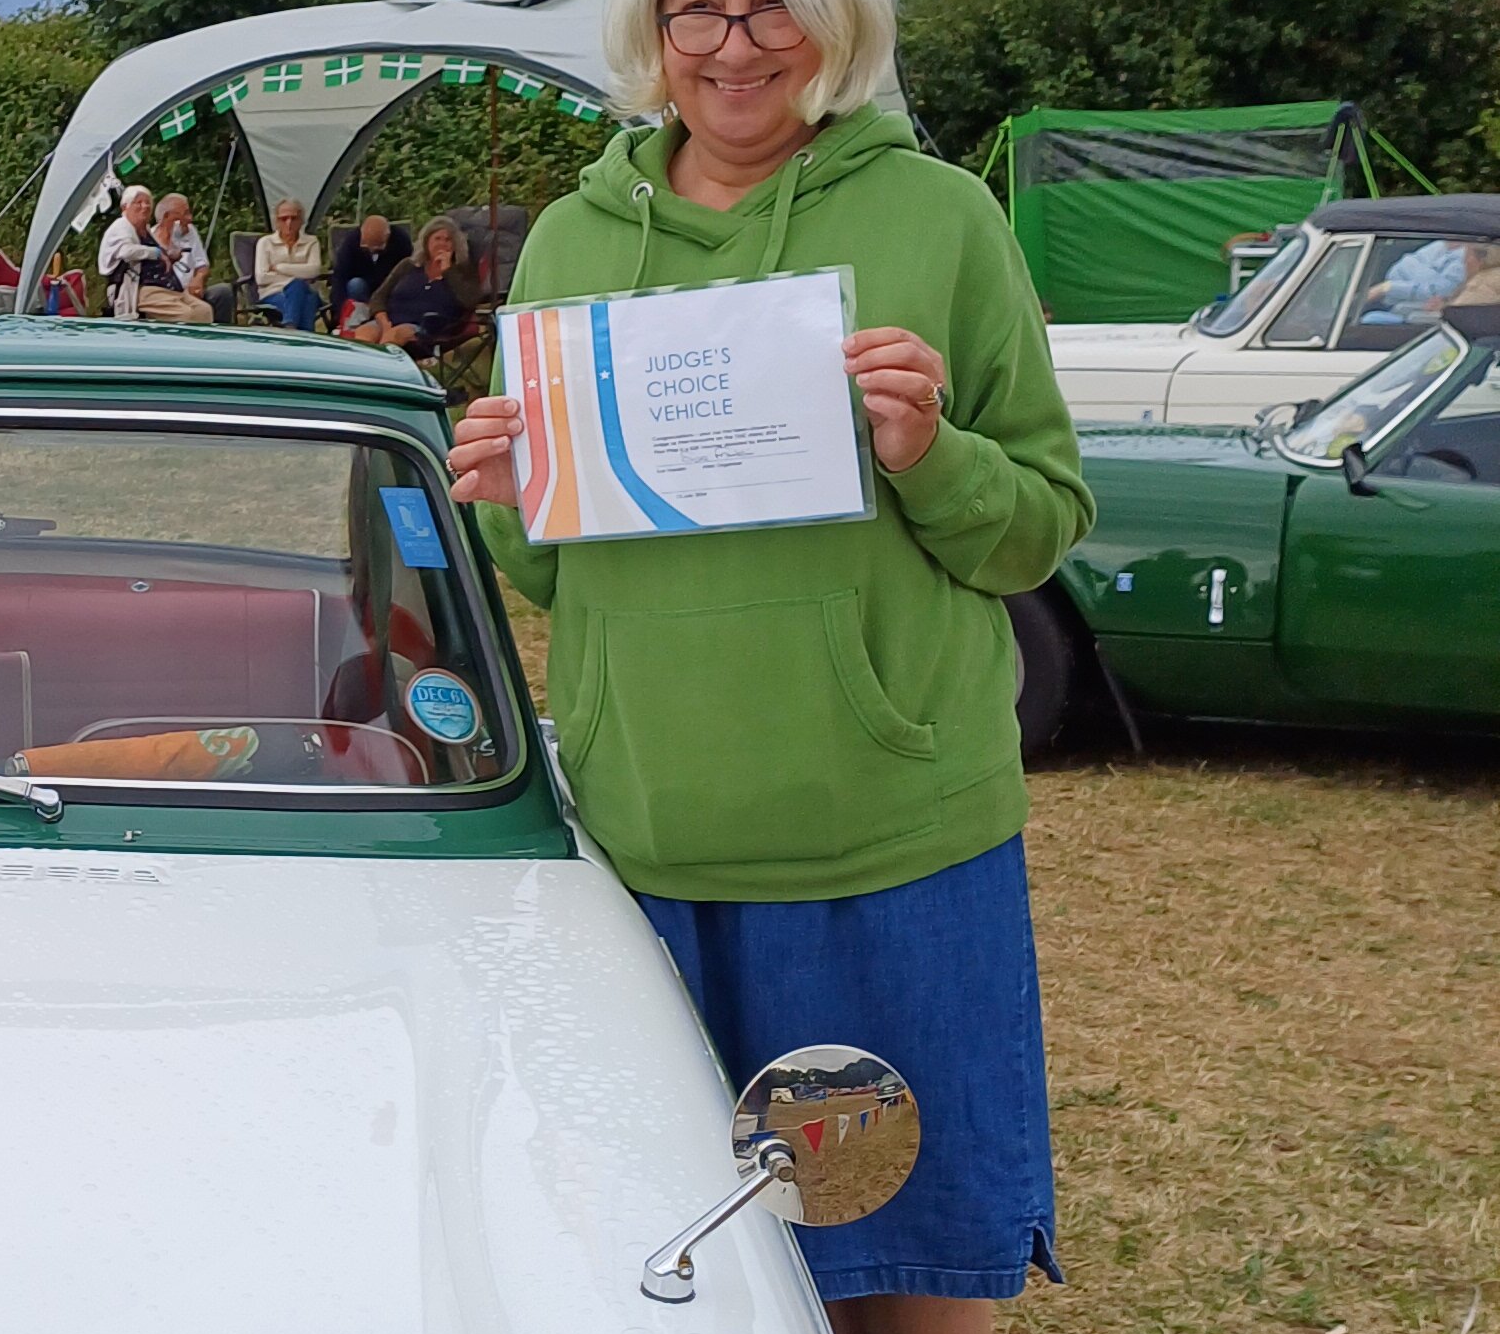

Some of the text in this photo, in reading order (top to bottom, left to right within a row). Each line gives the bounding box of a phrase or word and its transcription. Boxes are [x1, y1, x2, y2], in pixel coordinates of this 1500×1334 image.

[645, 347, 731, 373] JUDGE'S
[647, 373, 729, 397] CHOICE
[649, 398, 733, 422] VEHICLE
[415, 687, 468, 704] DEC 61
